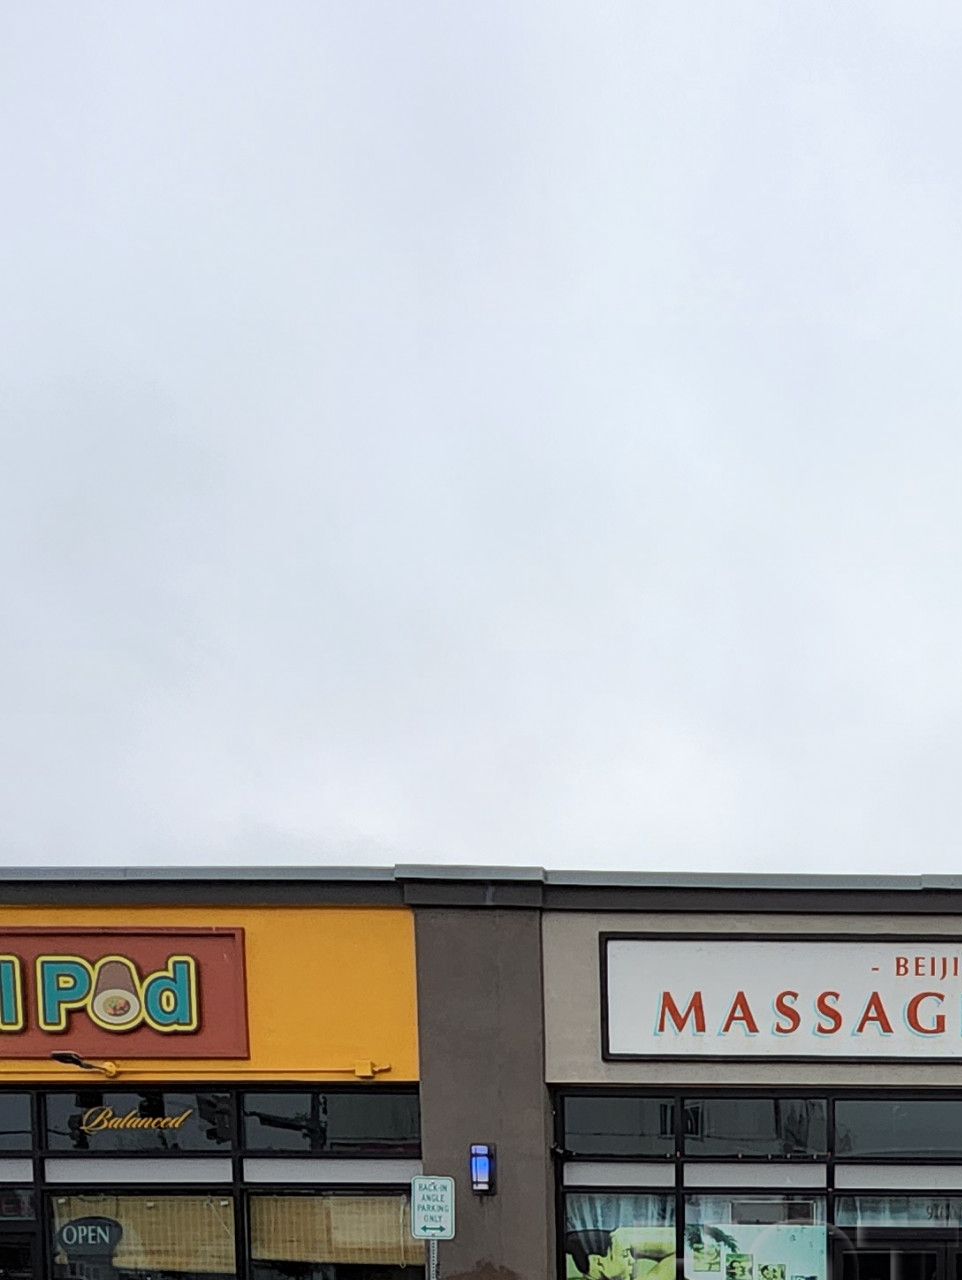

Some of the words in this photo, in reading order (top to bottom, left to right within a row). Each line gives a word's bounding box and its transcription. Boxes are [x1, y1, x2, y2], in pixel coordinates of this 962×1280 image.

[79, 1105, 193, 1135] Balanced
[418, 1184, 448, 1192] BACK-IN
[421, 1194, 445, 1202] ANGLE
[417, 1204, 450, 1212] PARKING
[62, 1225, 110, 1245] OPEN
